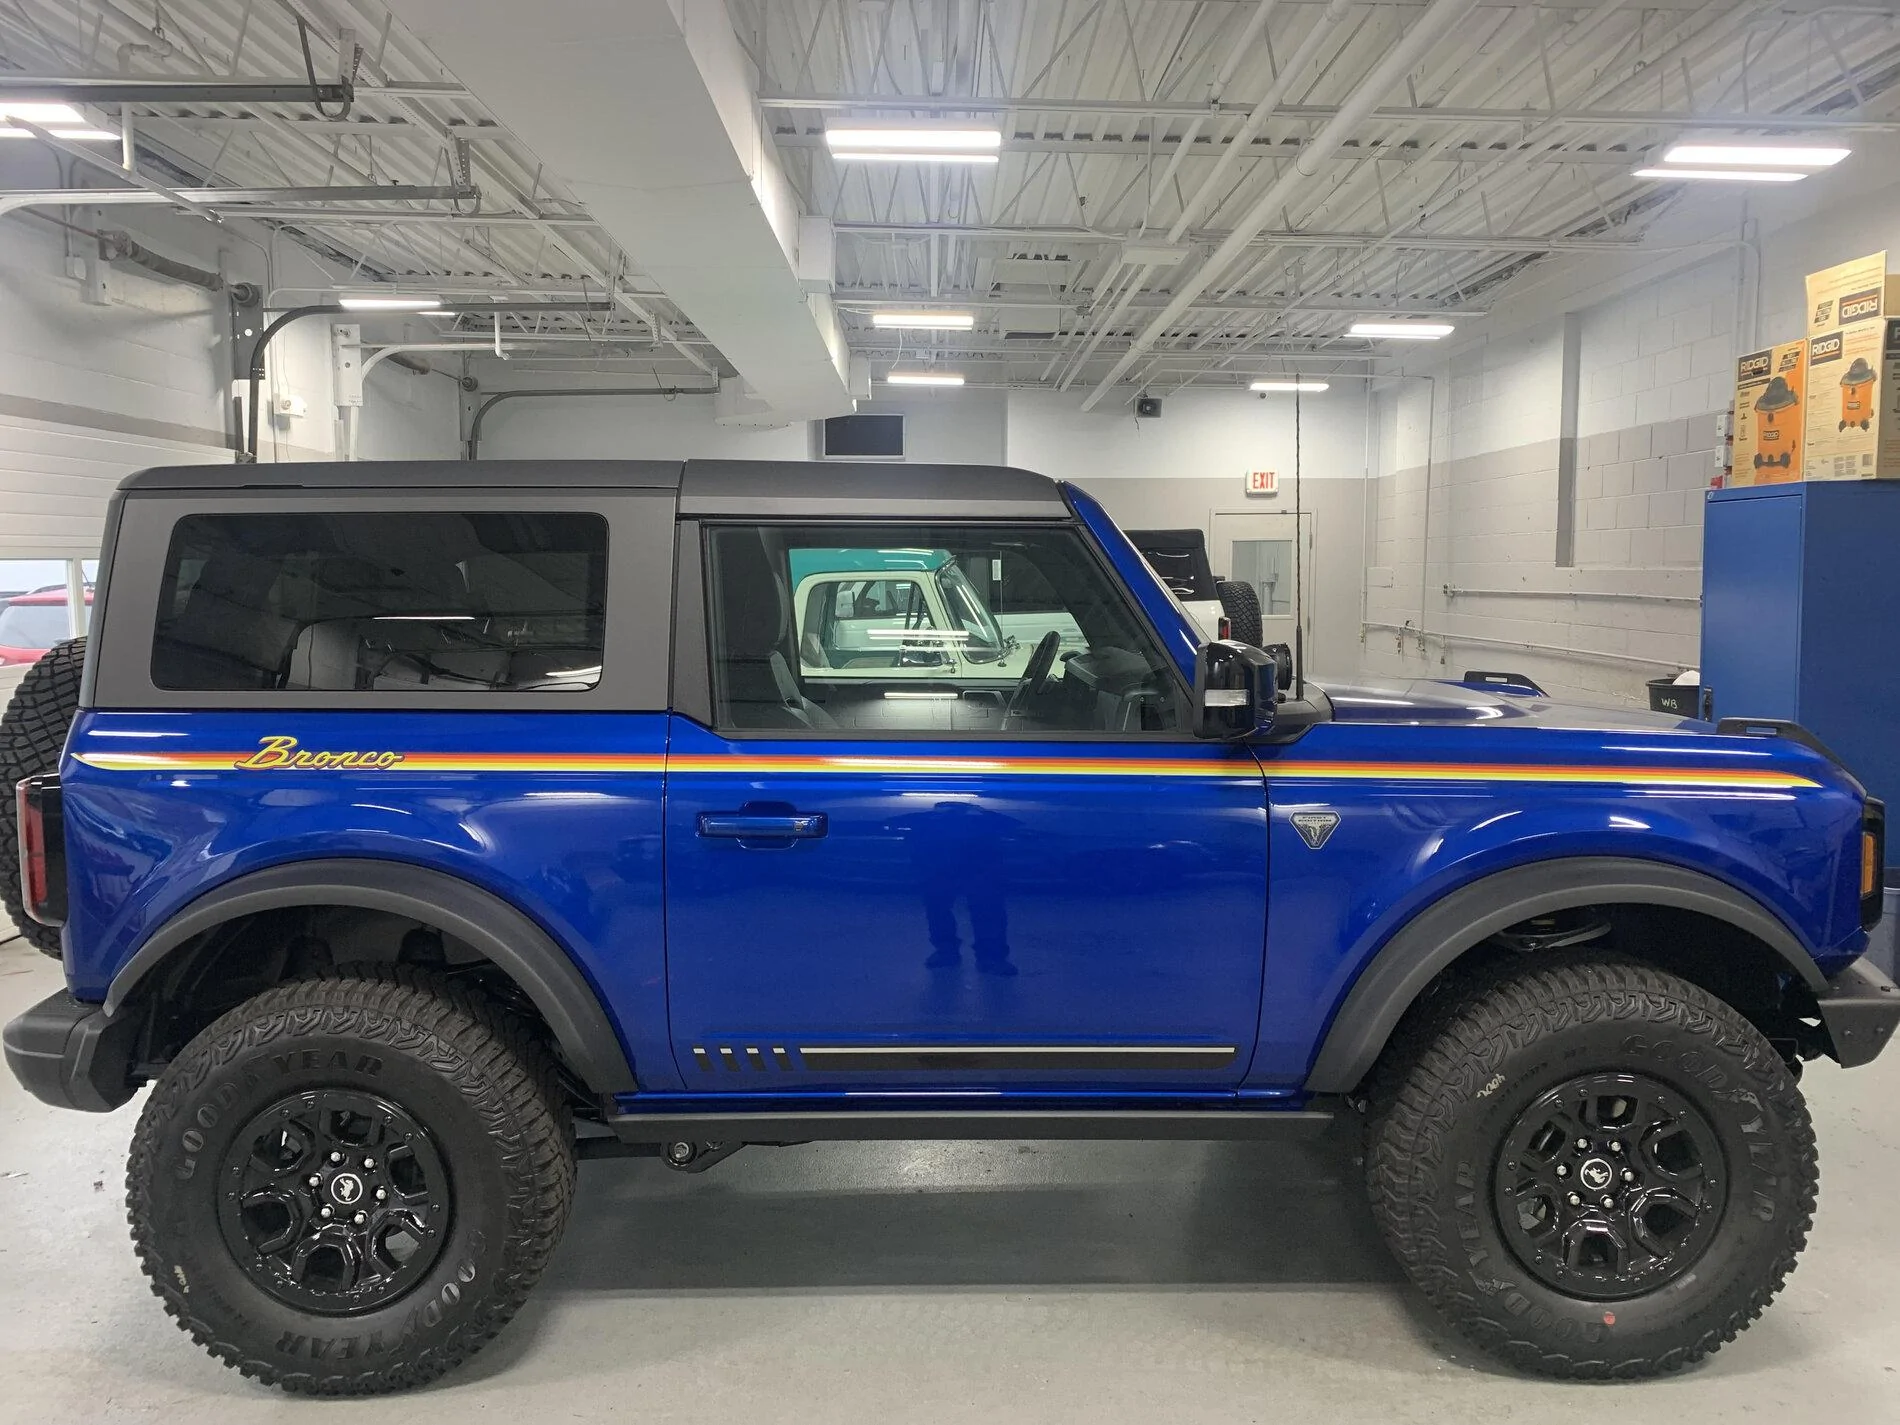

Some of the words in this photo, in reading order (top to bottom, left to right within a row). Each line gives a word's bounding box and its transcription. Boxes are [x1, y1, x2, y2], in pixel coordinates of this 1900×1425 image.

[1842, 298, 1878, 318] RIDGID
[1811, 338, 1840, 355] RIDGID
[1740, 356, 1769, 373] RIDGID
[1253, 472, 1275, 489] EXIT
[233, 735, 405, 769] Bronco
